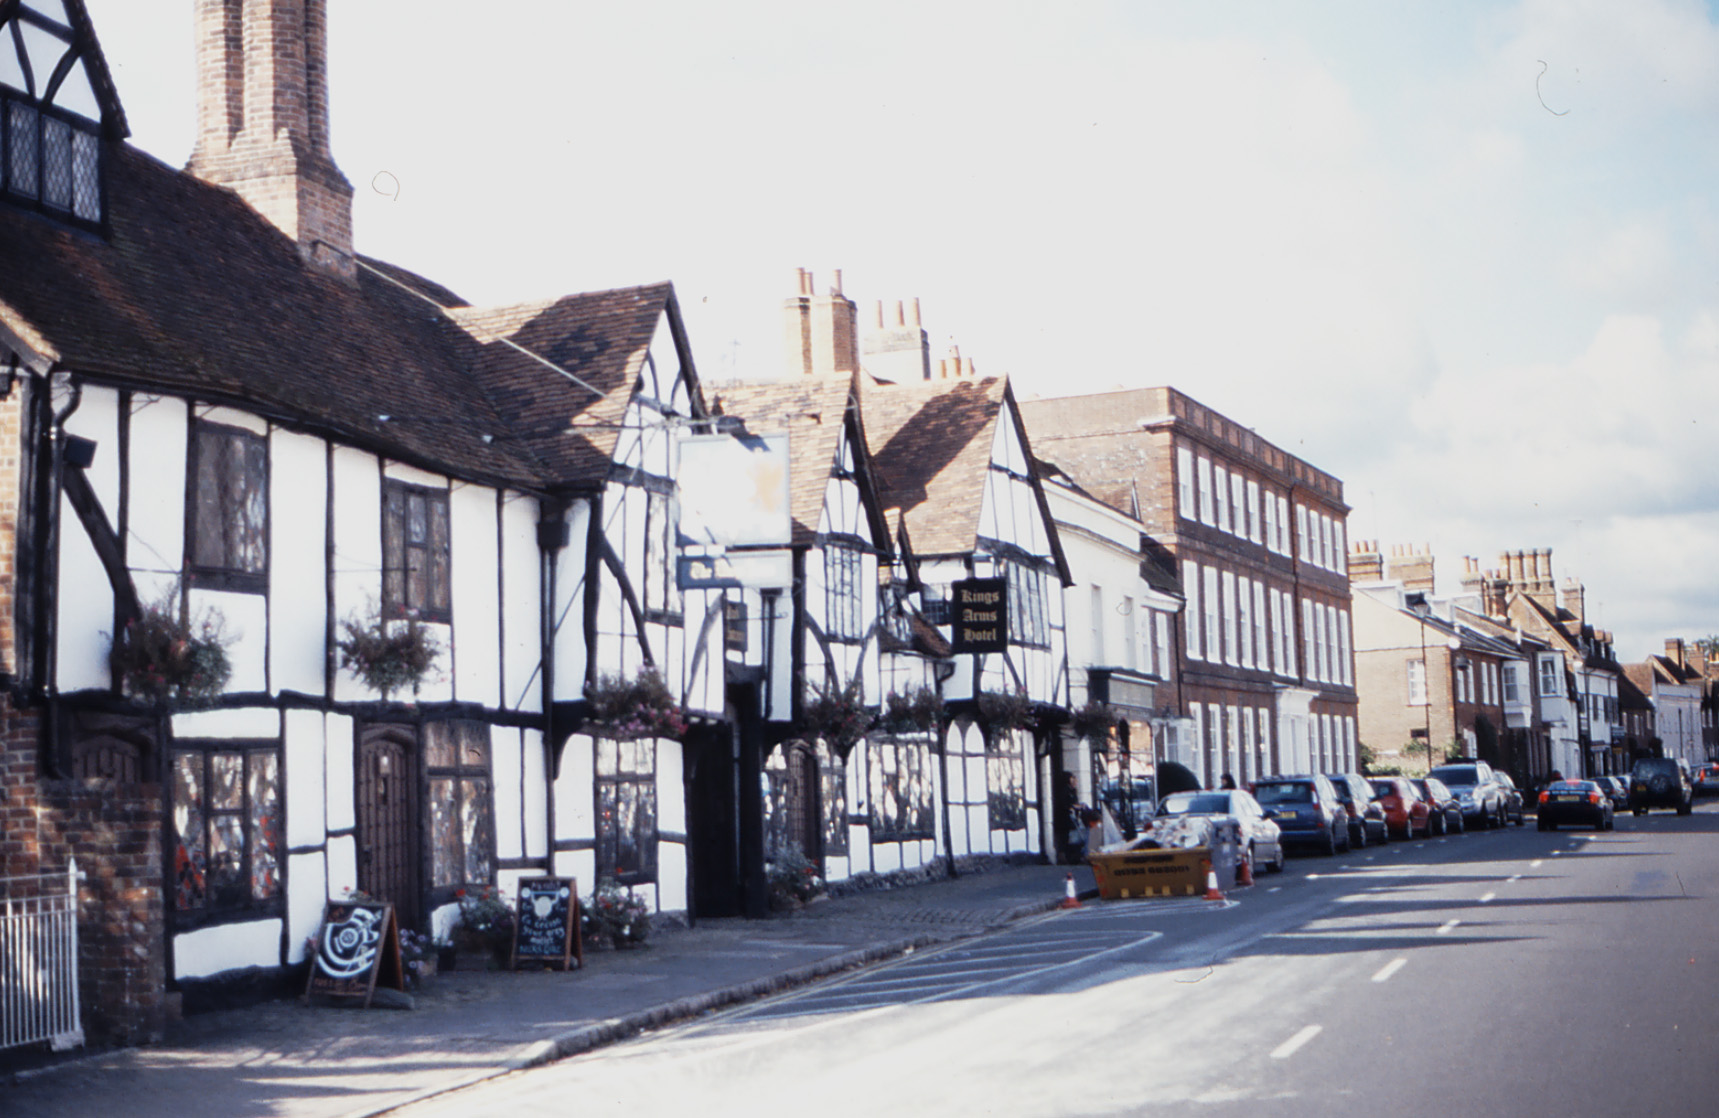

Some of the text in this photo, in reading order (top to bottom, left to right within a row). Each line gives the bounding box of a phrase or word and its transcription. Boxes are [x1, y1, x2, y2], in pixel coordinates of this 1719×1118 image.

[961, 589, 999, 605] Kings
[962, 608, 997, 622] Arms
[963, 628, 997, 643] Hotel
